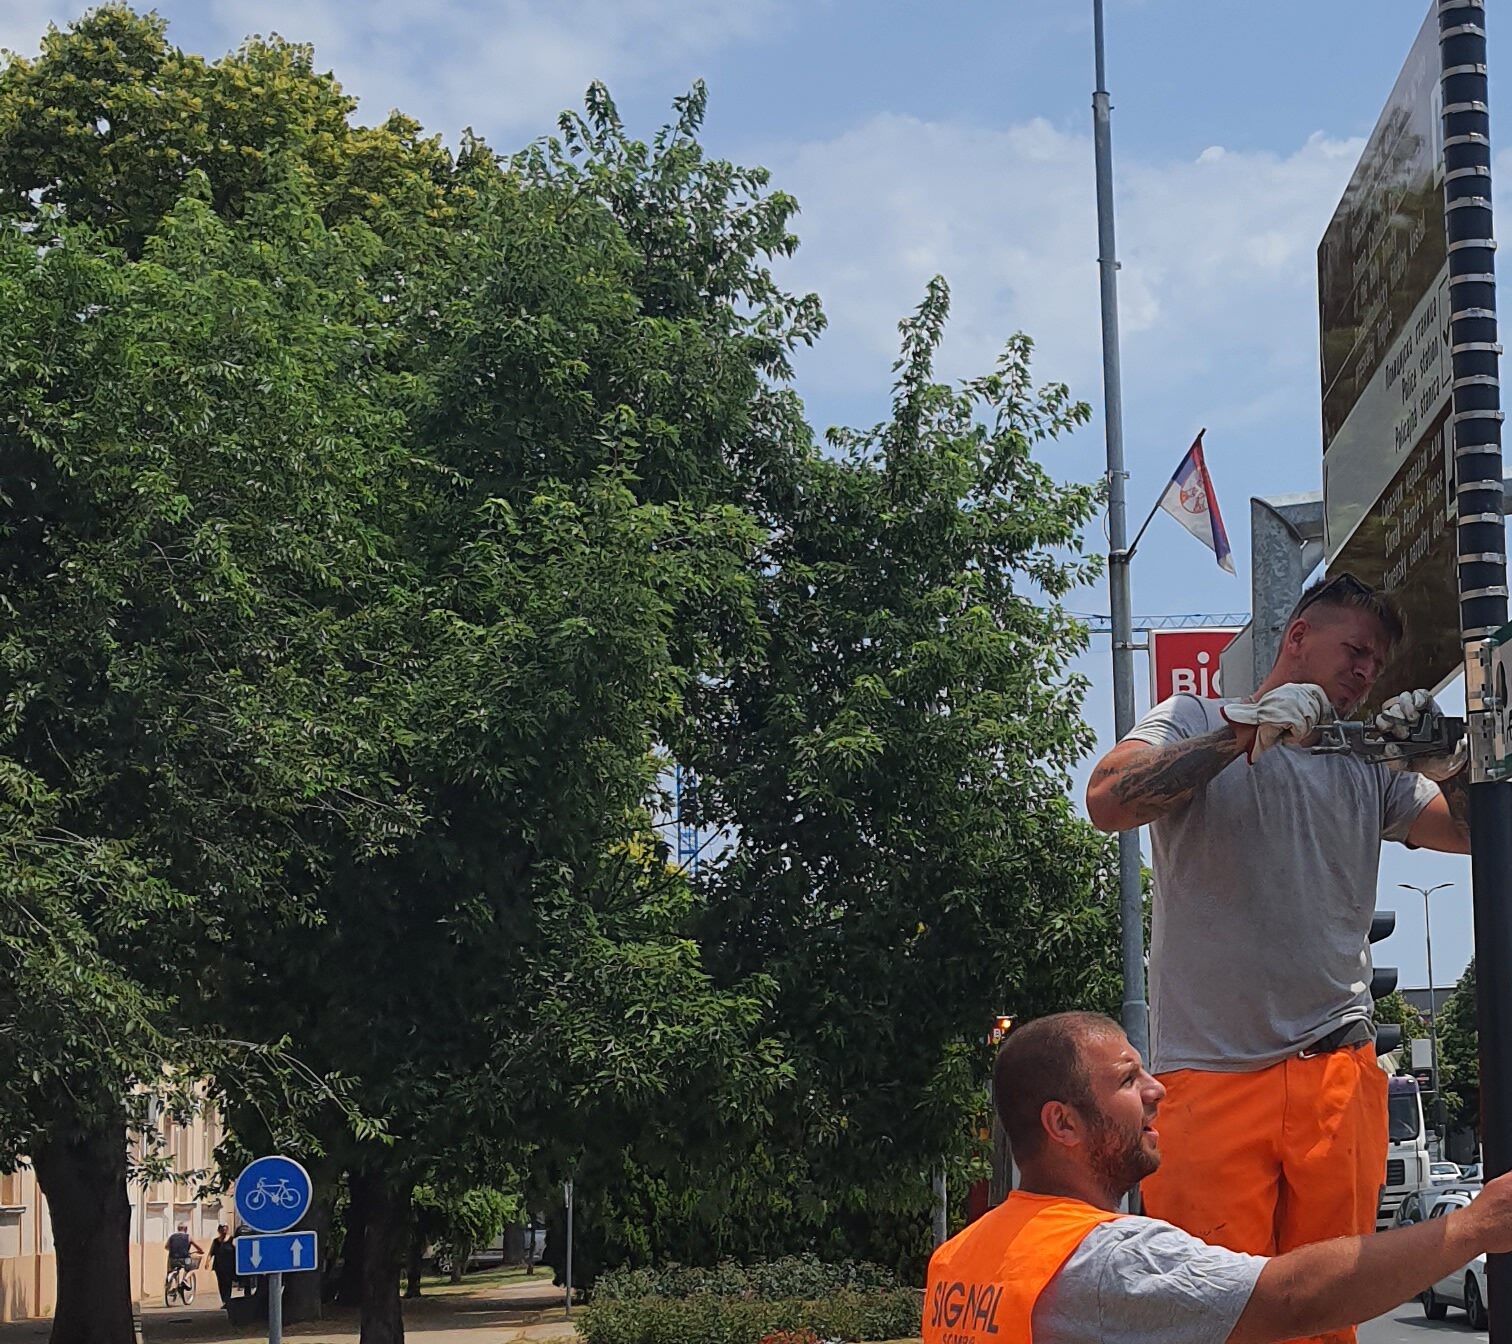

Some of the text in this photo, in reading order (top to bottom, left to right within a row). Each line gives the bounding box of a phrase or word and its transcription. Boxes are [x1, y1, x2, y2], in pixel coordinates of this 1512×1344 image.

[1401, 336, 1439, 406] Police station
[1420, 375, 1440, 419] stanica
[931, 1281, 1004, 1334] SIGNAL
